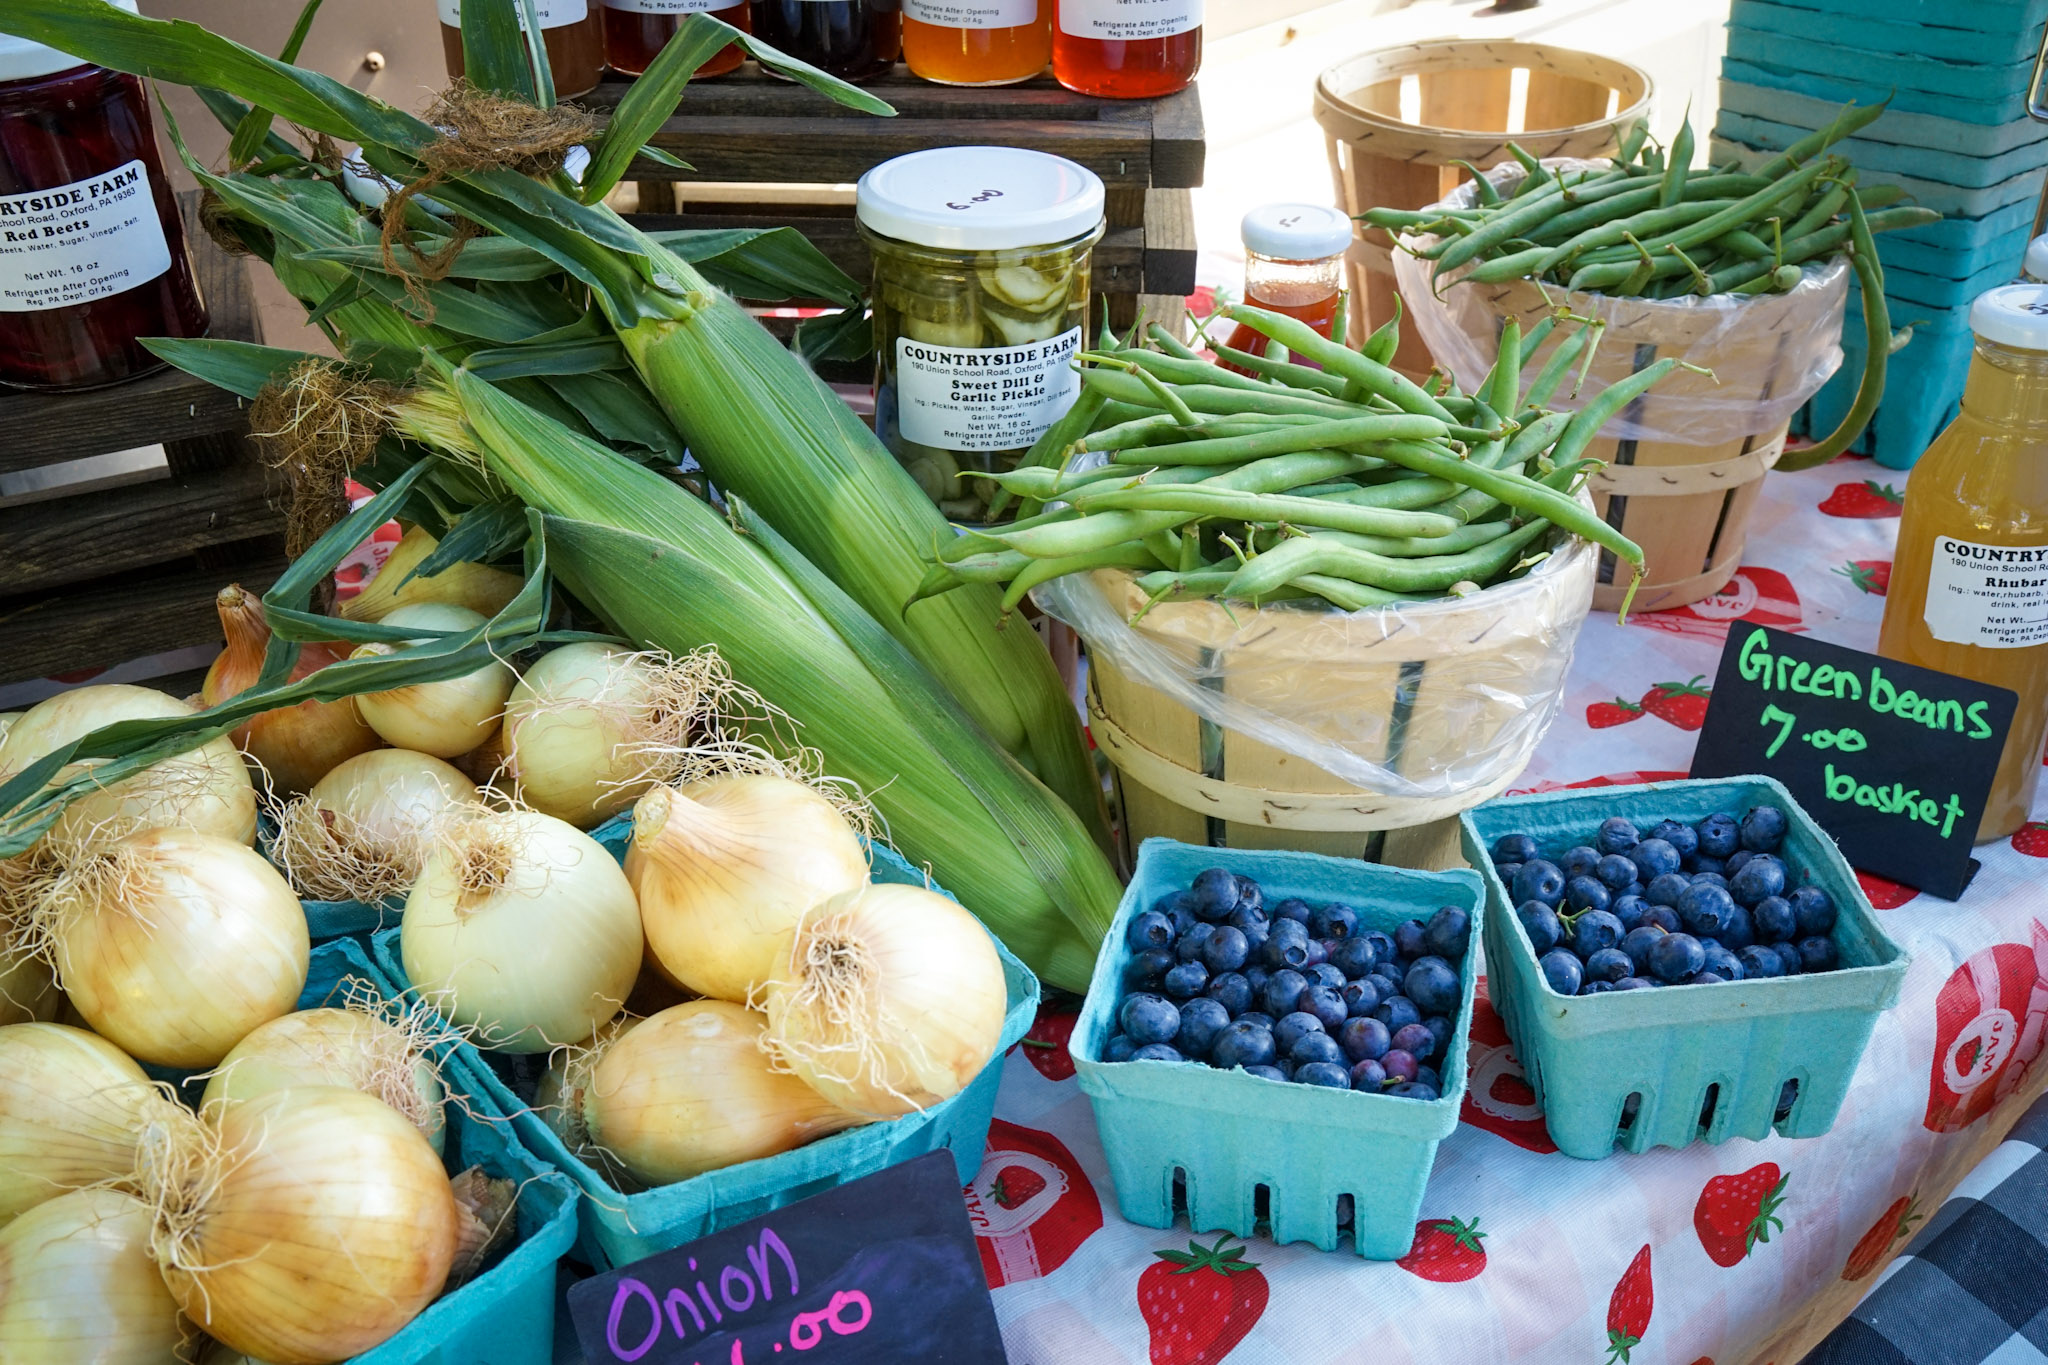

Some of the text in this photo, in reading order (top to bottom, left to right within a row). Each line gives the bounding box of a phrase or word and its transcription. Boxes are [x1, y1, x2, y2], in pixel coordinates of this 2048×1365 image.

[1093, 20, 1136, 29] Refrigerate
[1161, 15, 1188, 26] Opening
[88, 168, 138, 198] FARM
[27, 213, 58, 224] Road,
[60, 203, 98, 218] Oxford,
[99, 198, 112, 208] PA
[114, 187, 136, 202] 19363
[4, 220, 90, 242] Red Beets
[28, 242, 57, 252] Water,
[59, 236, 88, 246] Sugar,
[90, 224, 122, 238] Vinegar,
[24, 272, 44, 281] Net
[70, 264, 83, 274] 16
[86, 262, 100, 270] oz
[4, 268, 130, 298] Refrigerate After Opening
[89, 288, 99, 296] Of
[904, 333, 1078, 366] COUNTRYSIDE FARM
[912, 361, 924, 370] 190
[926, 364, 950, 375] Union
[952, 368, 984, 377] School
[986, 368, 1012, 376] Road,
[1015, 363, 1044, 374] Oxford,
[1046, 359, 1056, 368] PA
[952, 374, 1044, 390] Sweet Dill &
[950, 387, 1046, 402] Garlic Pickle
[1048, 394, 1058, 402] Dill
[944, 430, 992, 440] Refrigerate
[1952, 558, 1966, 567] 190
[1970, 562, 1998, 572] Union
[2002, 564, 2036, 572] School
[2022, 600, 2040, 608] real
[1987, 616, 2006, 624] Net
[1980, 626, 2034, 636] Refrigerate
[1738, 628, 1992, 740] Green beans
[1760, 704, 1868, 759] 7.00
[1824, 763, 1965, 840] basket
[1982, 1020, 2004, 1076] JAM
[606, 1226, 799, 1362] Onion
